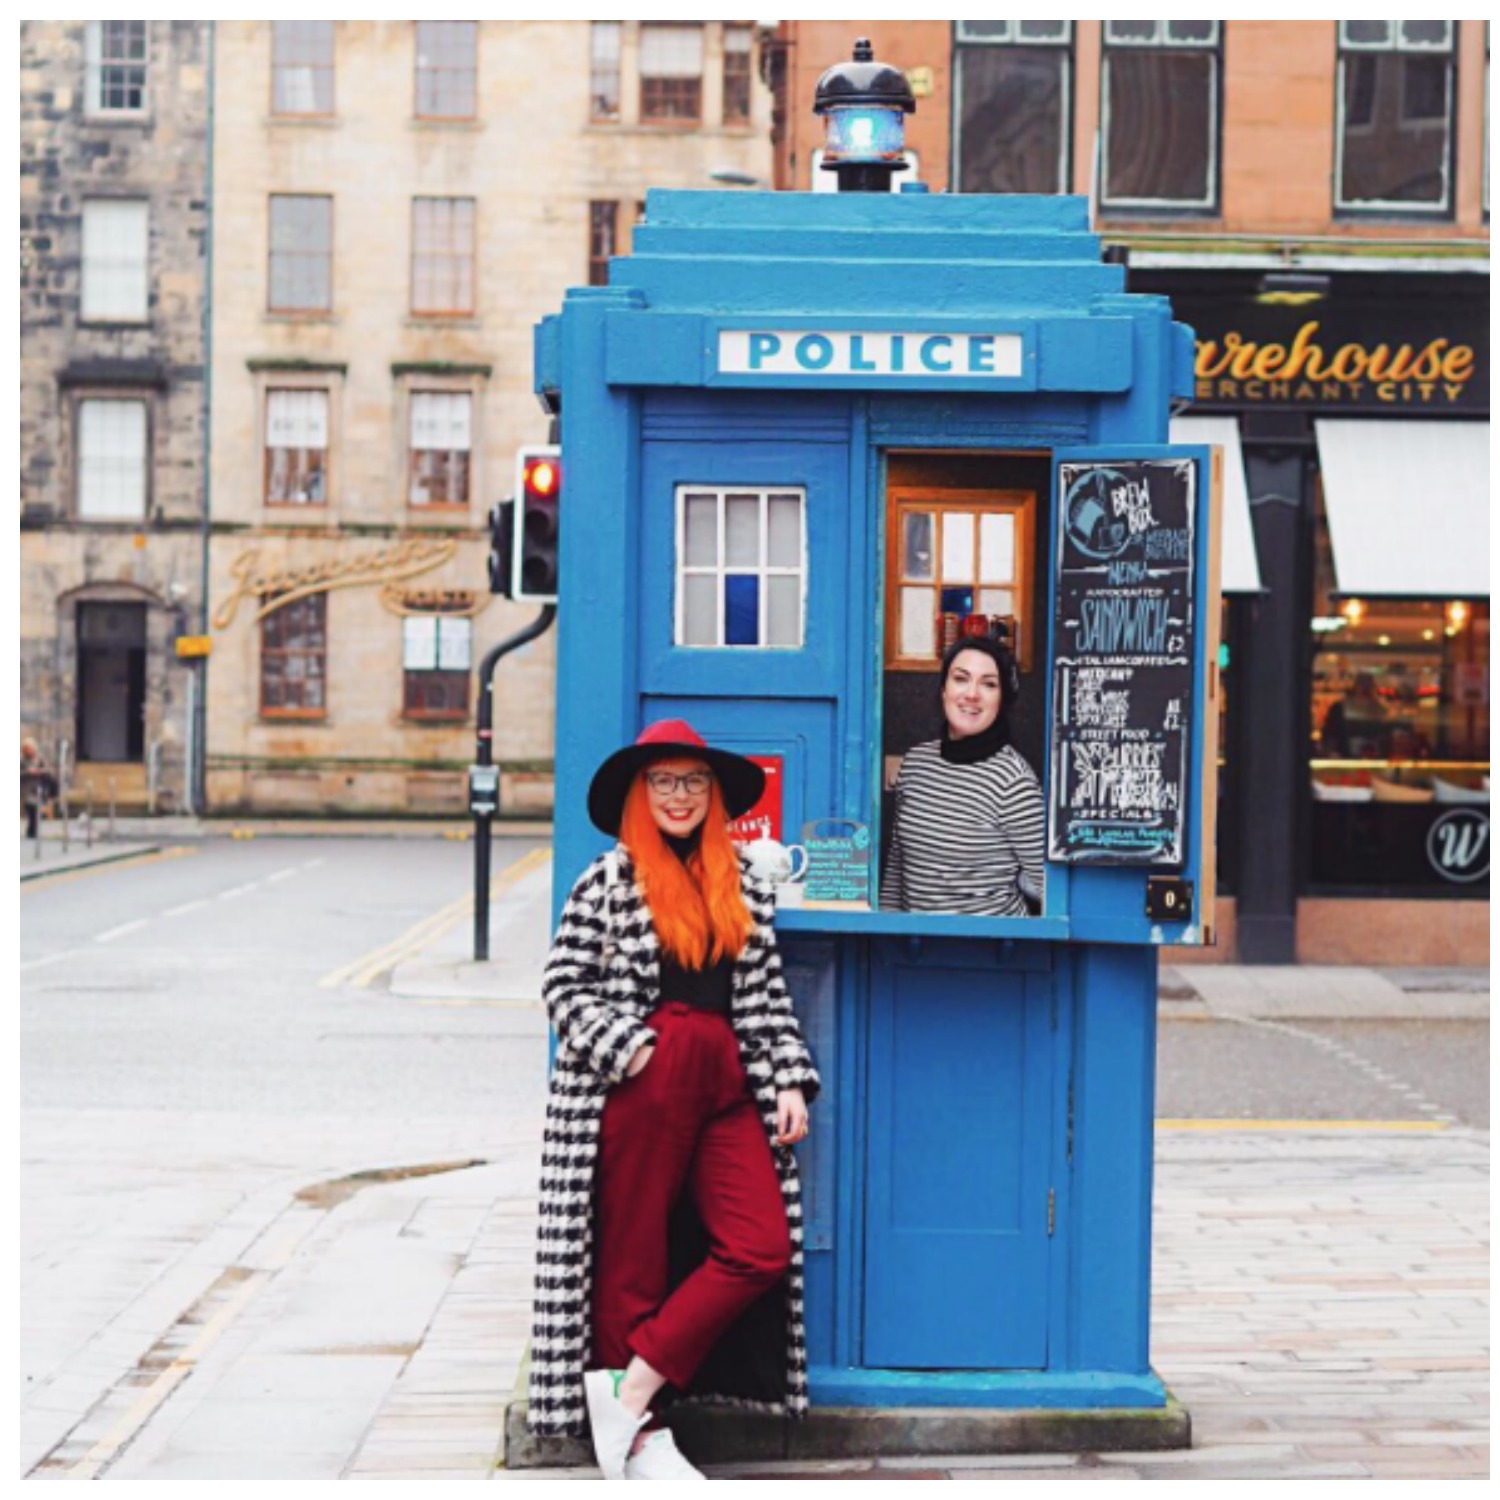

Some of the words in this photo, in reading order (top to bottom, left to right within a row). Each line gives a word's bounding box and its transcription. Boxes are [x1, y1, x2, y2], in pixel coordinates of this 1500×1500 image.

[748, 333, 996, 372] POLICE
[1194, 320, 1475, 382] arehouse
[1195, 380, 1364, 399] ERCHANT
[1376, 381, 1463, 401] CITY
[1075, 598, 1169, 653] SANDWICH
